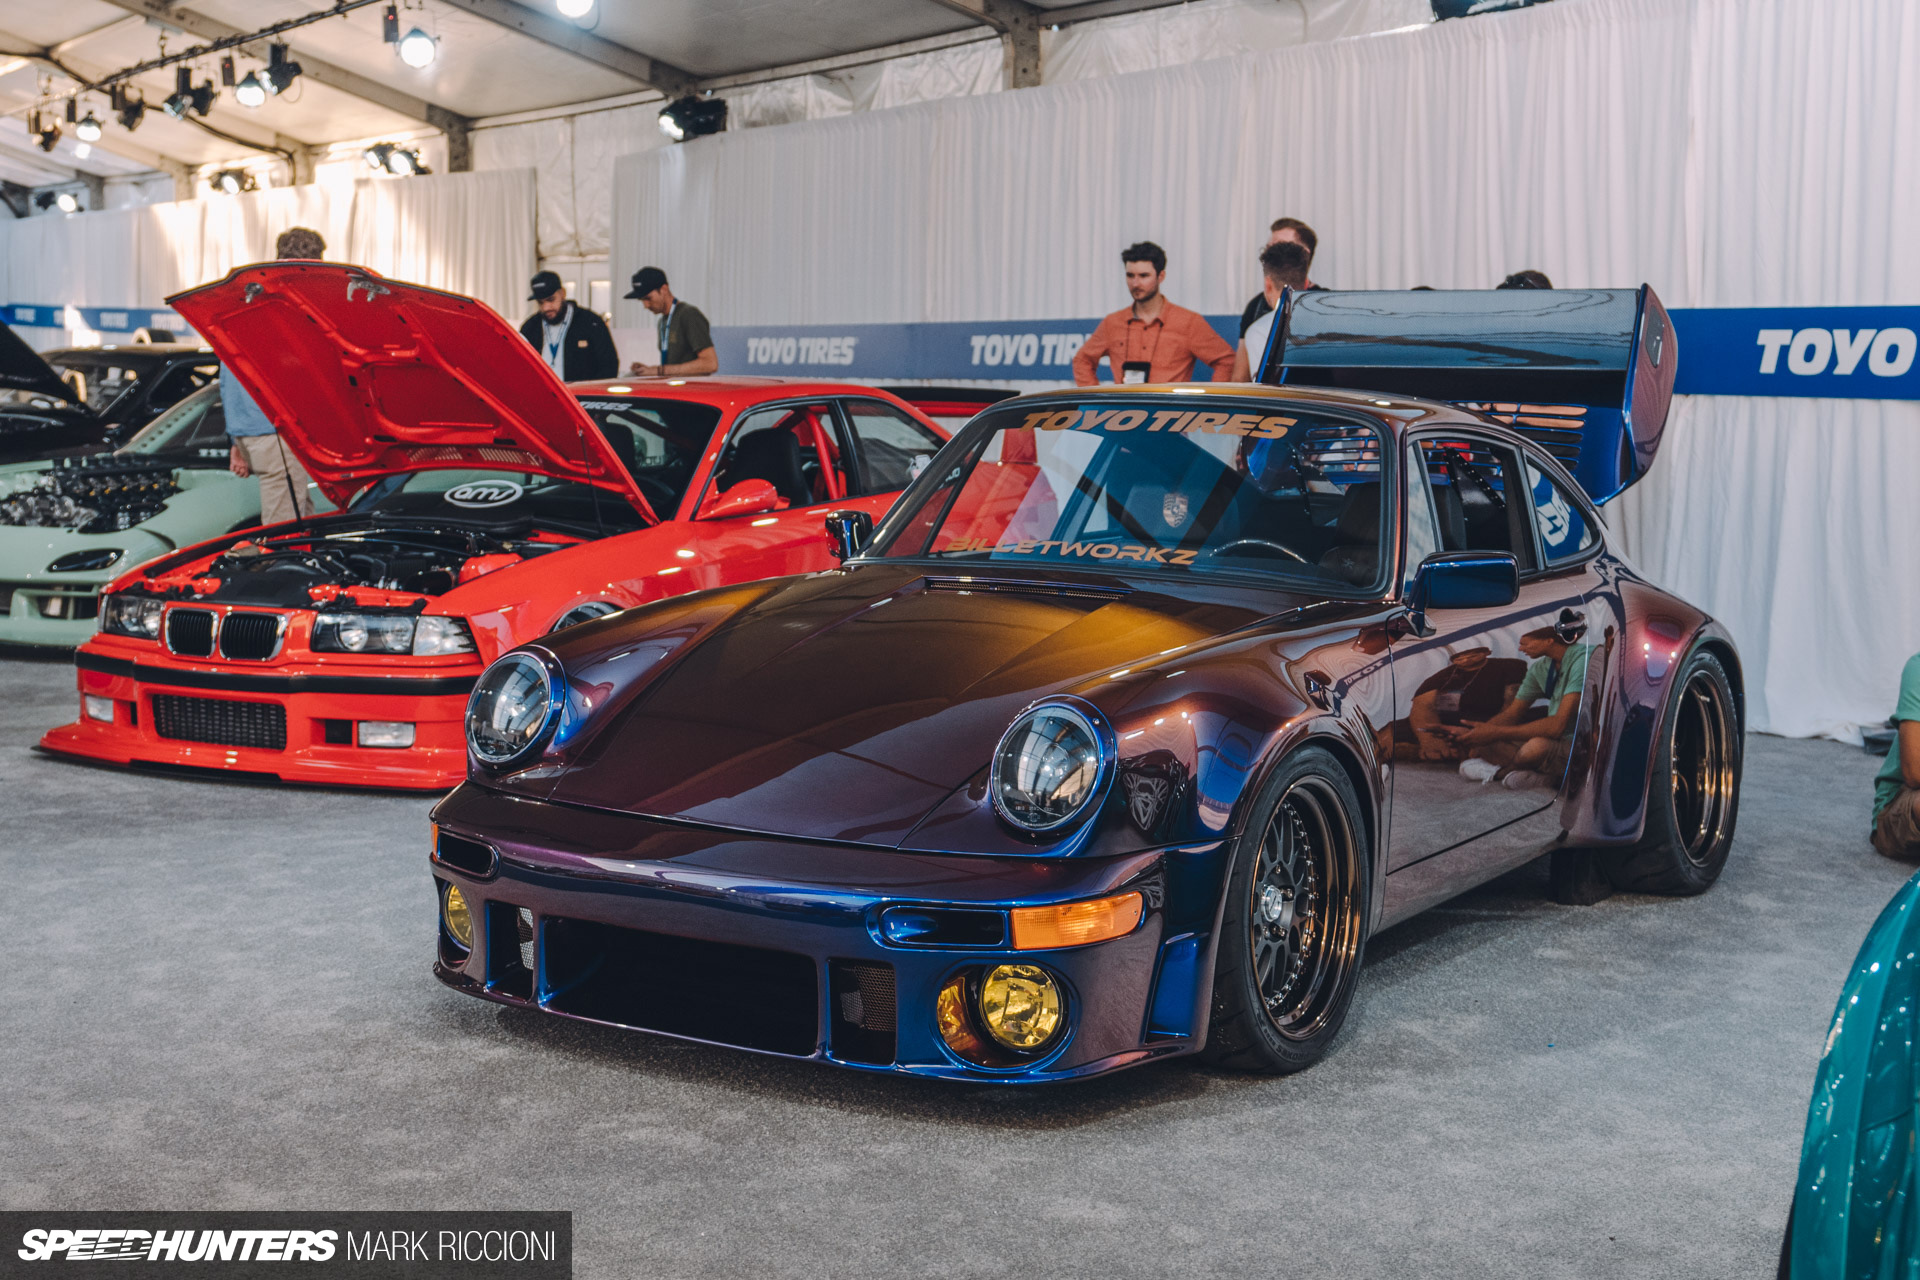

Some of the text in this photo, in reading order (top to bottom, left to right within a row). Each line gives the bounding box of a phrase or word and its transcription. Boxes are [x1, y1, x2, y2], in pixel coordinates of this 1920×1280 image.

[747, 336, 856, 366] TOYO TIRES
[970, 333, 1111, 366] TOYO TIR
[1756, 327, 1918, 377] TOYO
[1019, 409, 1299, 440] TOYO TIRES
[946, 537, 1199, 566] BILLETWORKZ
